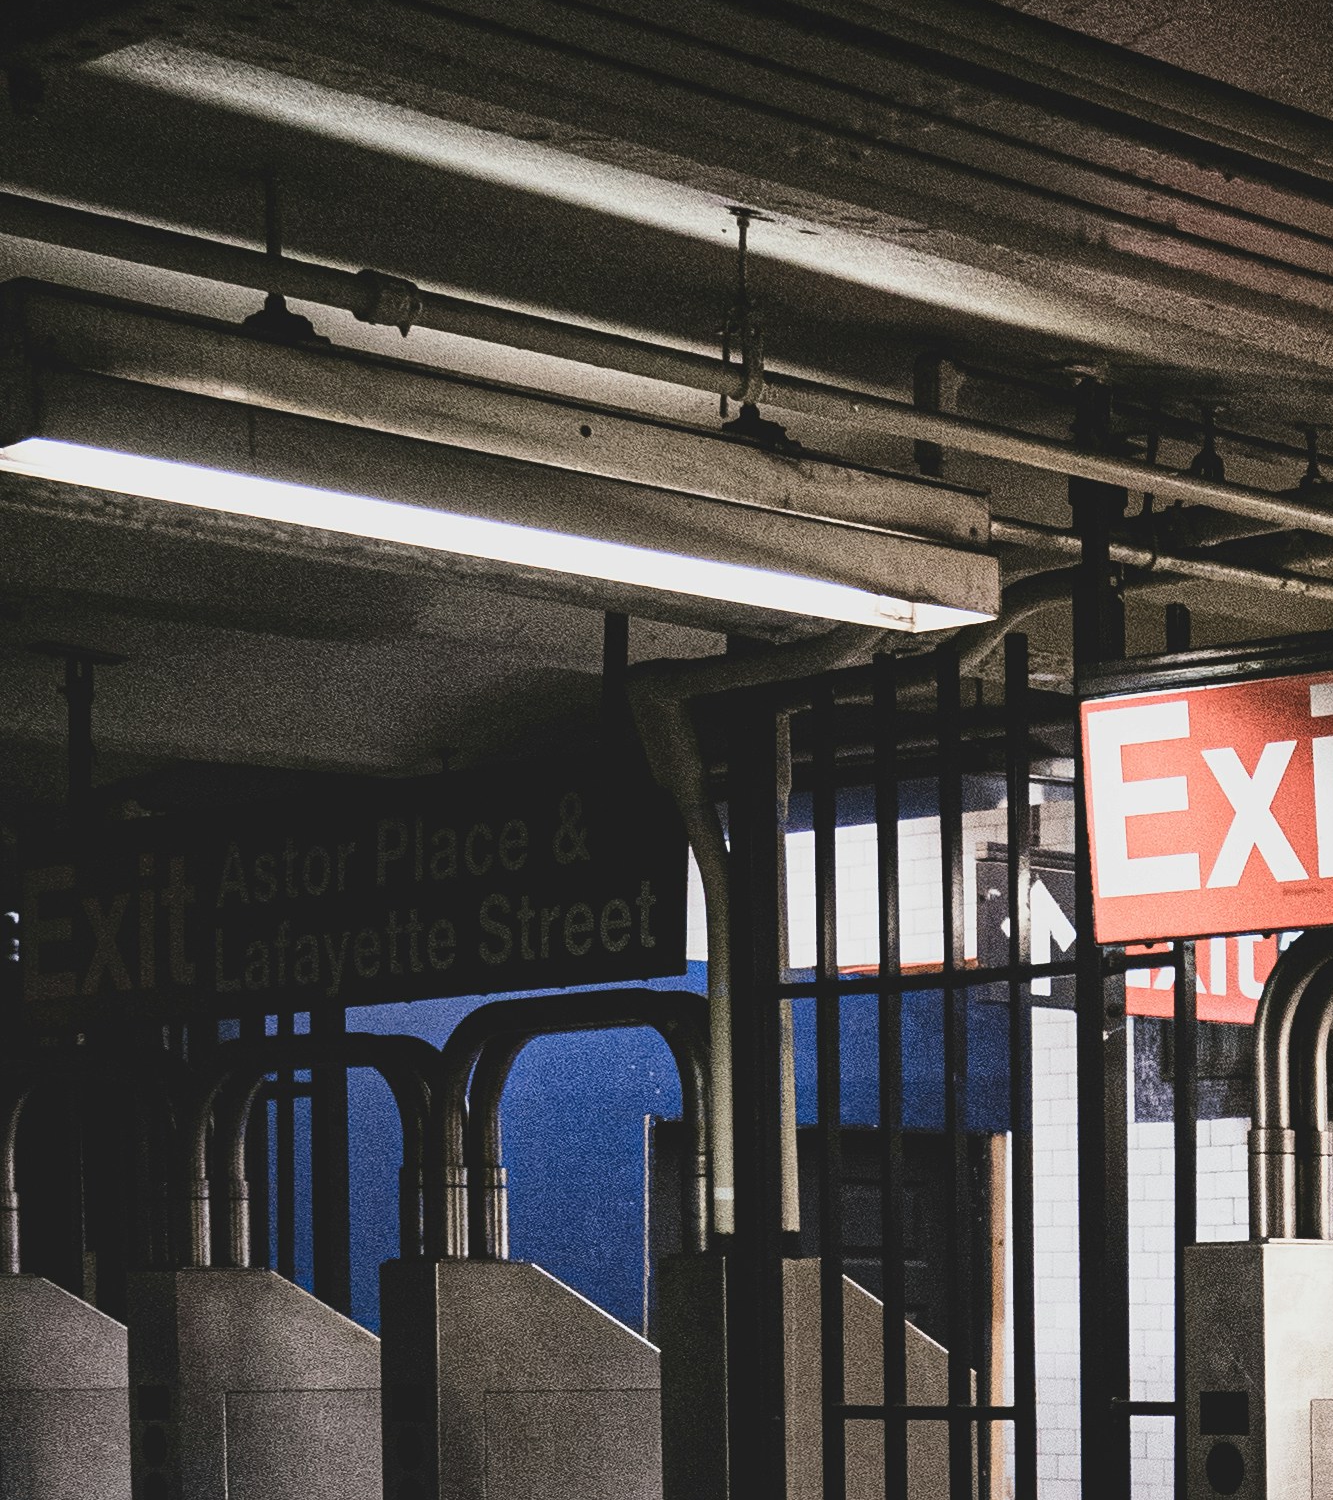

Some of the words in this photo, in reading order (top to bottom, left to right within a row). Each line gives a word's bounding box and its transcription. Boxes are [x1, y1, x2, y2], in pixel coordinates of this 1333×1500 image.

[216, 839, 356, 908] Astor
[376, 813, 529, 886] Place
[553, 791, 590, 865] &
[23, 853, 197, 1000] Exit
[215, 908, 458, 998] Lafayette
[480, 879, 657, 965] Street
